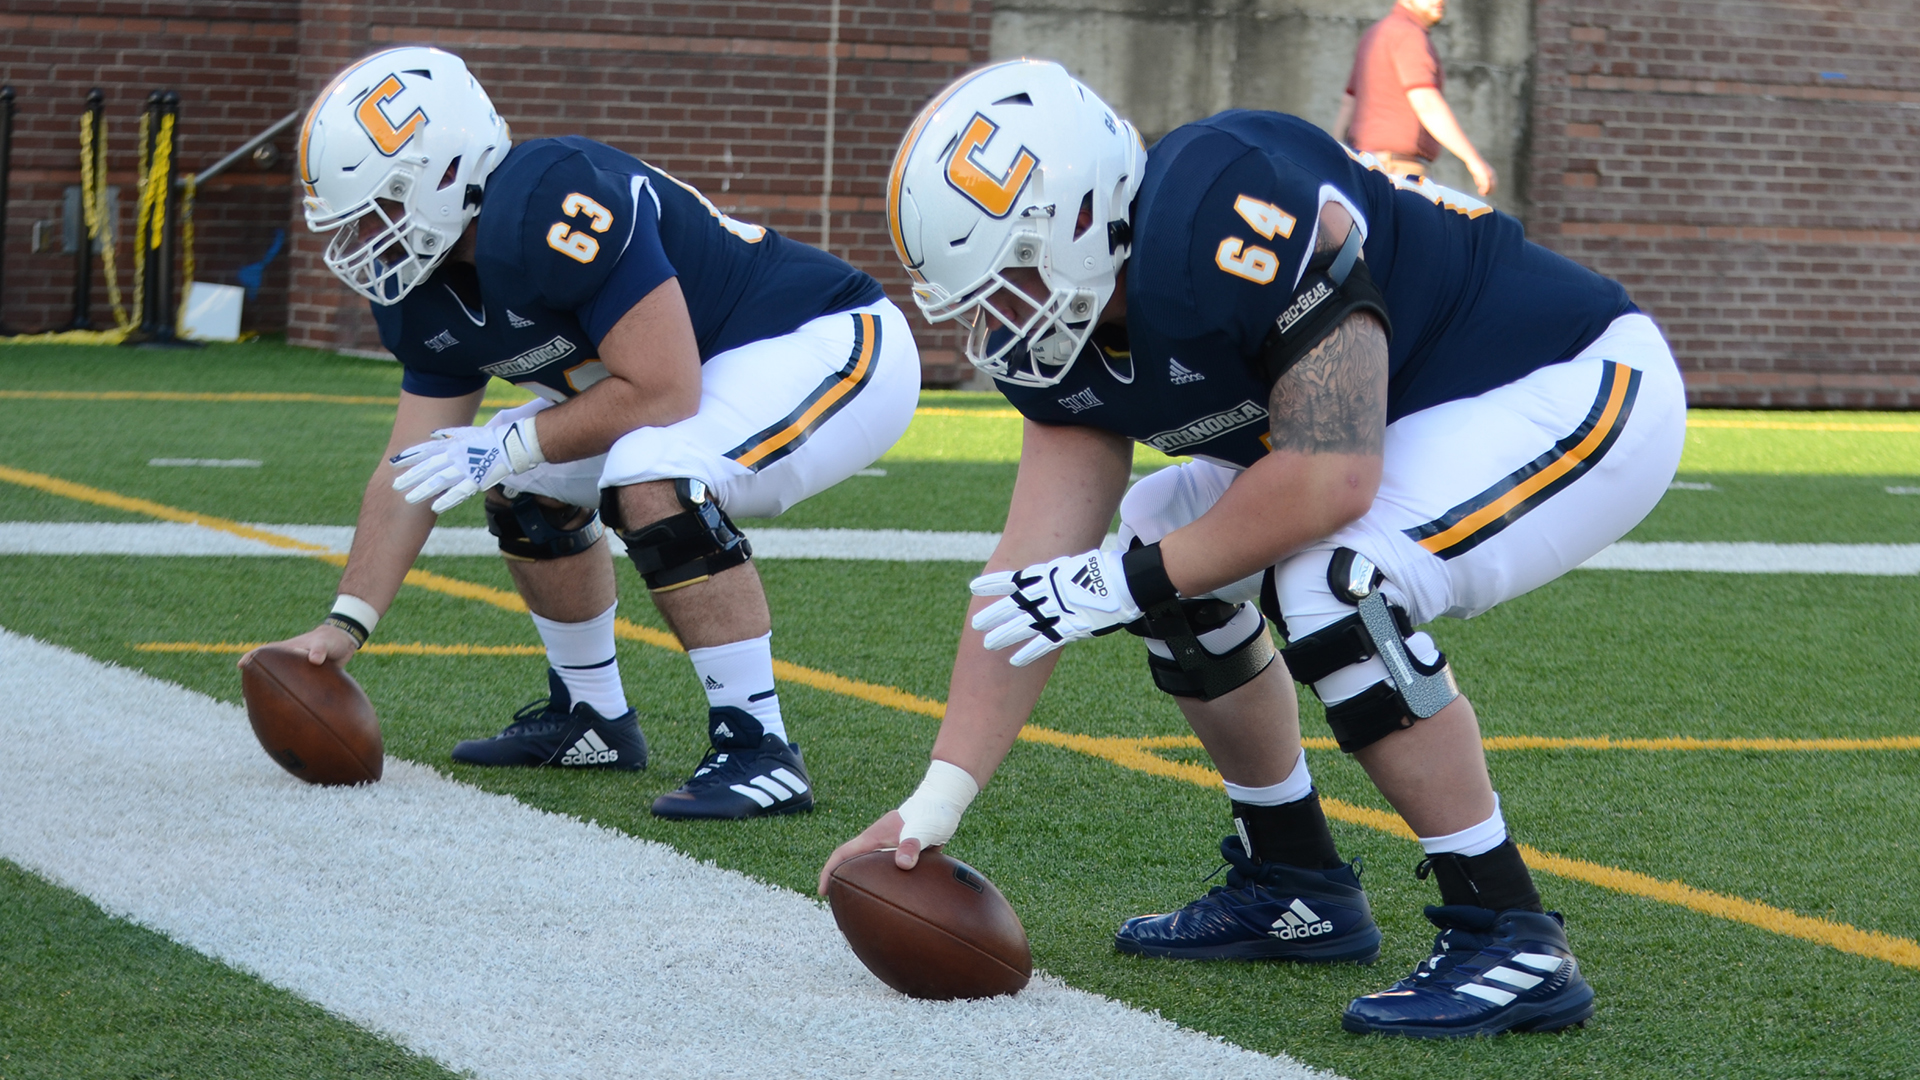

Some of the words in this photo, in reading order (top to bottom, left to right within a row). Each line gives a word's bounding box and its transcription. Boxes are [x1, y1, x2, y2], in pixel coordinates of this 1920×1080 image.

[944, 111, 1041, 220] C
[546, 192, 614, 264] 63
[1215, 194, 1297, 285] 64
[1276, 282, 1328, 330] PRO-GEAR
[1170, 373, 1205, 385] adidas
[1058, 387, 1103, 414] SOCON
[474, 447, 499, 484] adidas
[1088, 556, 1108, 597] adidas
[561, 749, 619, 766] adidas
